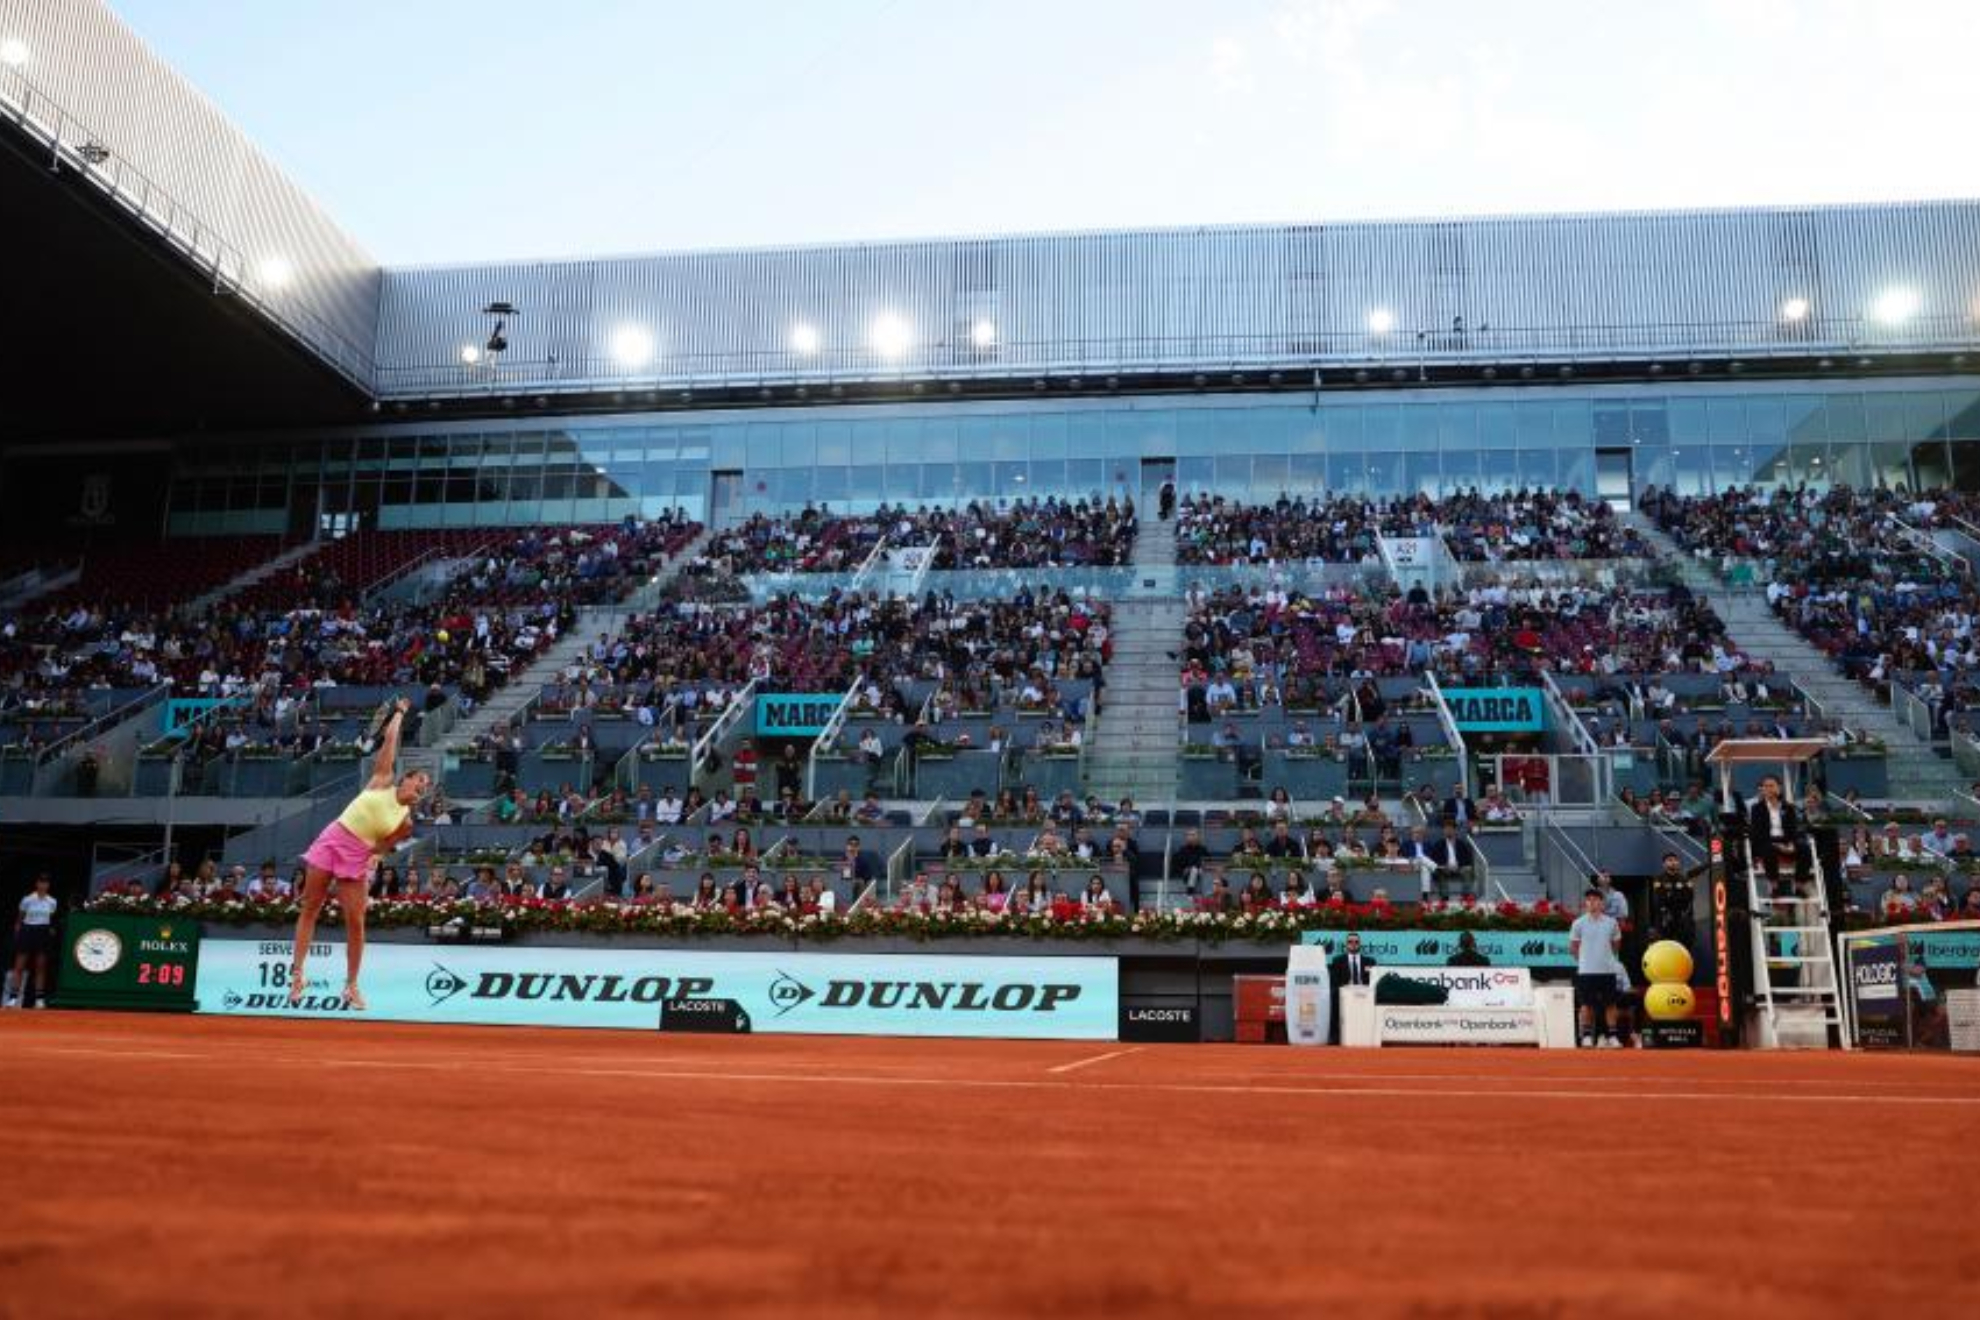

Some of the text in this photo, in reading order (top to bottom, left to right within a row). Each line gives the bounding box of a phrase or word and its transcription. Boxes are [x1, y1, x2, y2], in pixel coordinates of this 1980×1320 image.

[766, 702, 841, 727] MARC
[141, 940, 188, 953] ROLEX
[137, 963, 185, 986] 2:09
[470, 973, 714, 1002] DUNLOP
[818, 980, 1082, 1011] DUNLOP
[669, 1001, 726, 1012] LACOSTE
[1129, 1010, 1191, 1022] LACOSTE
